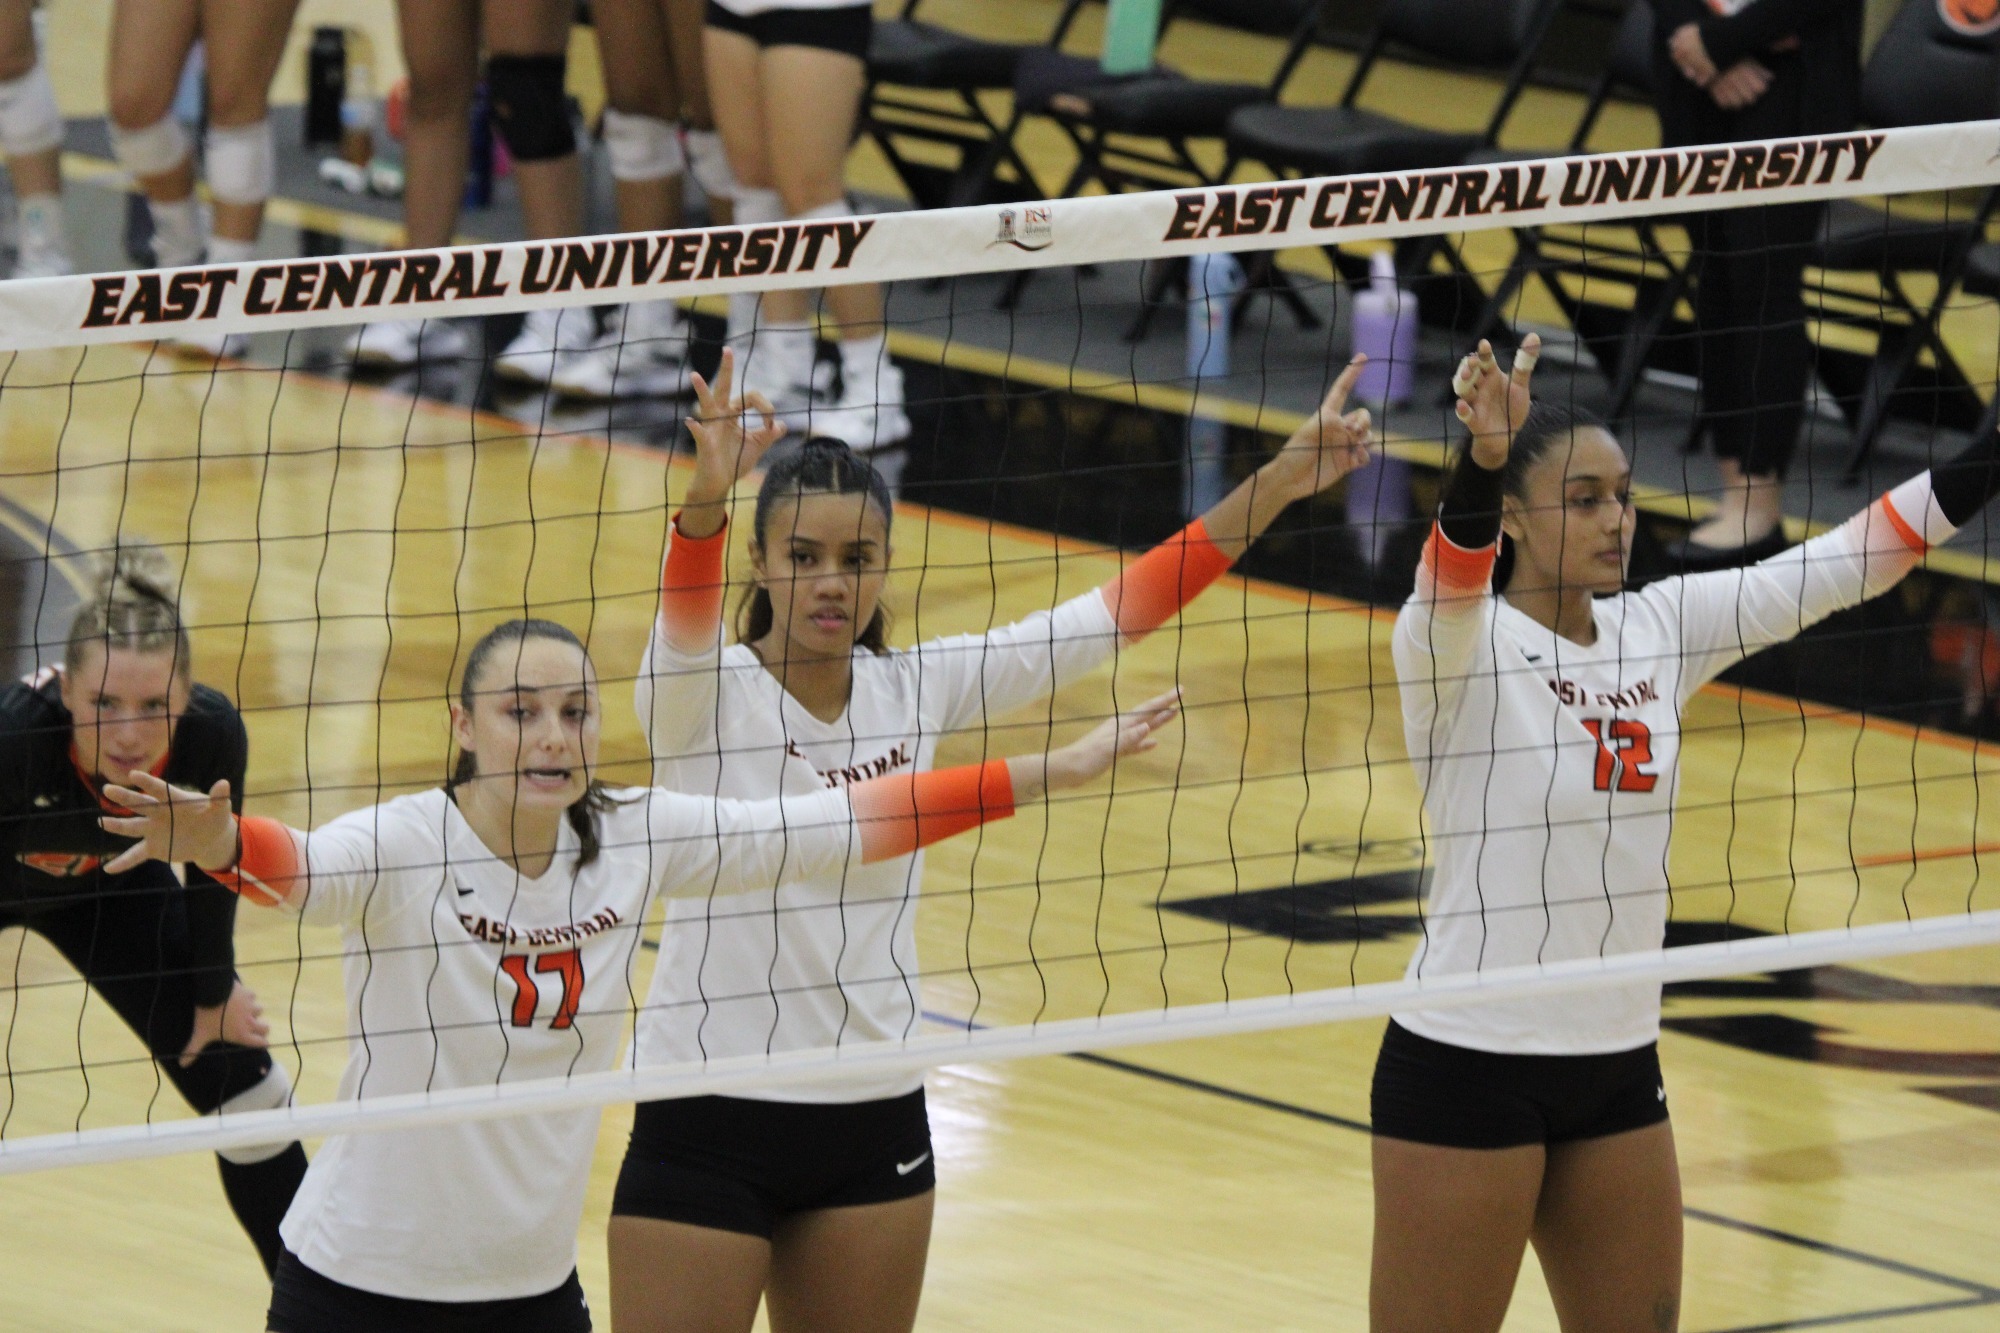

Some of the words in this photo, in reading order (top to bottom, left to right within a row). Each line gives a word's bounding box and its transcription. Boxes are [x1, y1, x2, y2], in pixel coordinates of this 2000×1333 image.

[1163, 183, 1307, 241] EAST
[1309, 162, 1551, 230] CENTRAL
[1559, 134, 1886, 206] UNIVERSITY
[80, 269, 238, 329] EAST
[243, 249, 511, 316] CENTRAL
[519, 220, 876, 294] UNIVERSITY
[1580, 717, 1659, 792] 12
[500, 948, 585, 1030] 17
